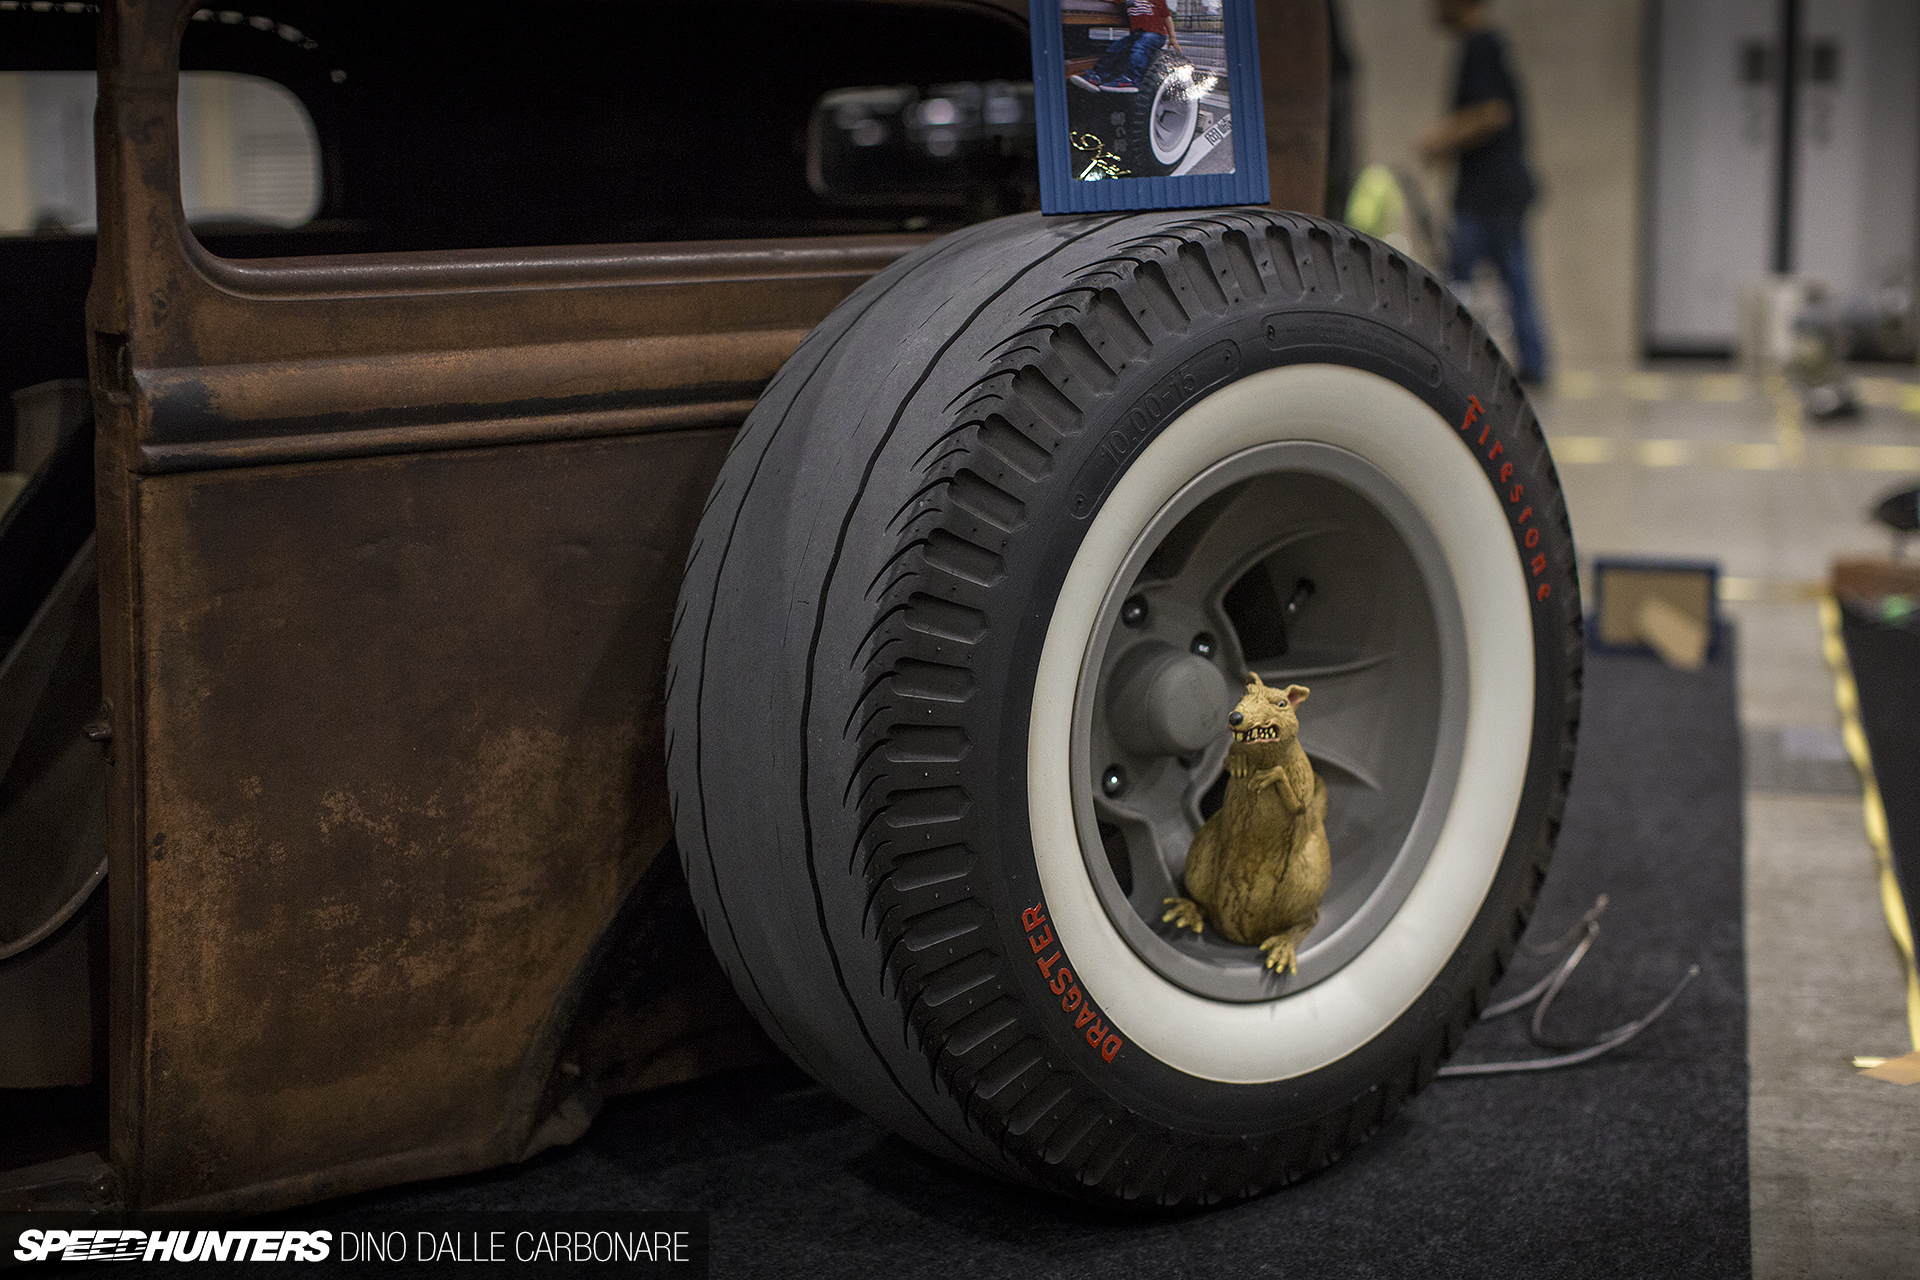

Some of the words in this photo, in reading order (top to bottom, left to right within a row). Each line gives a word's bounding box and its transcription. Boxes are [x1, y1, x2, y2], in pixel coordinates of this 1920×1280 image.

[1100, 364, 1197, 467] 10.00-15
[1461, 395, 1552, 601] Firestone
[1021, 902, 1123, 1064] DRAGSTER
